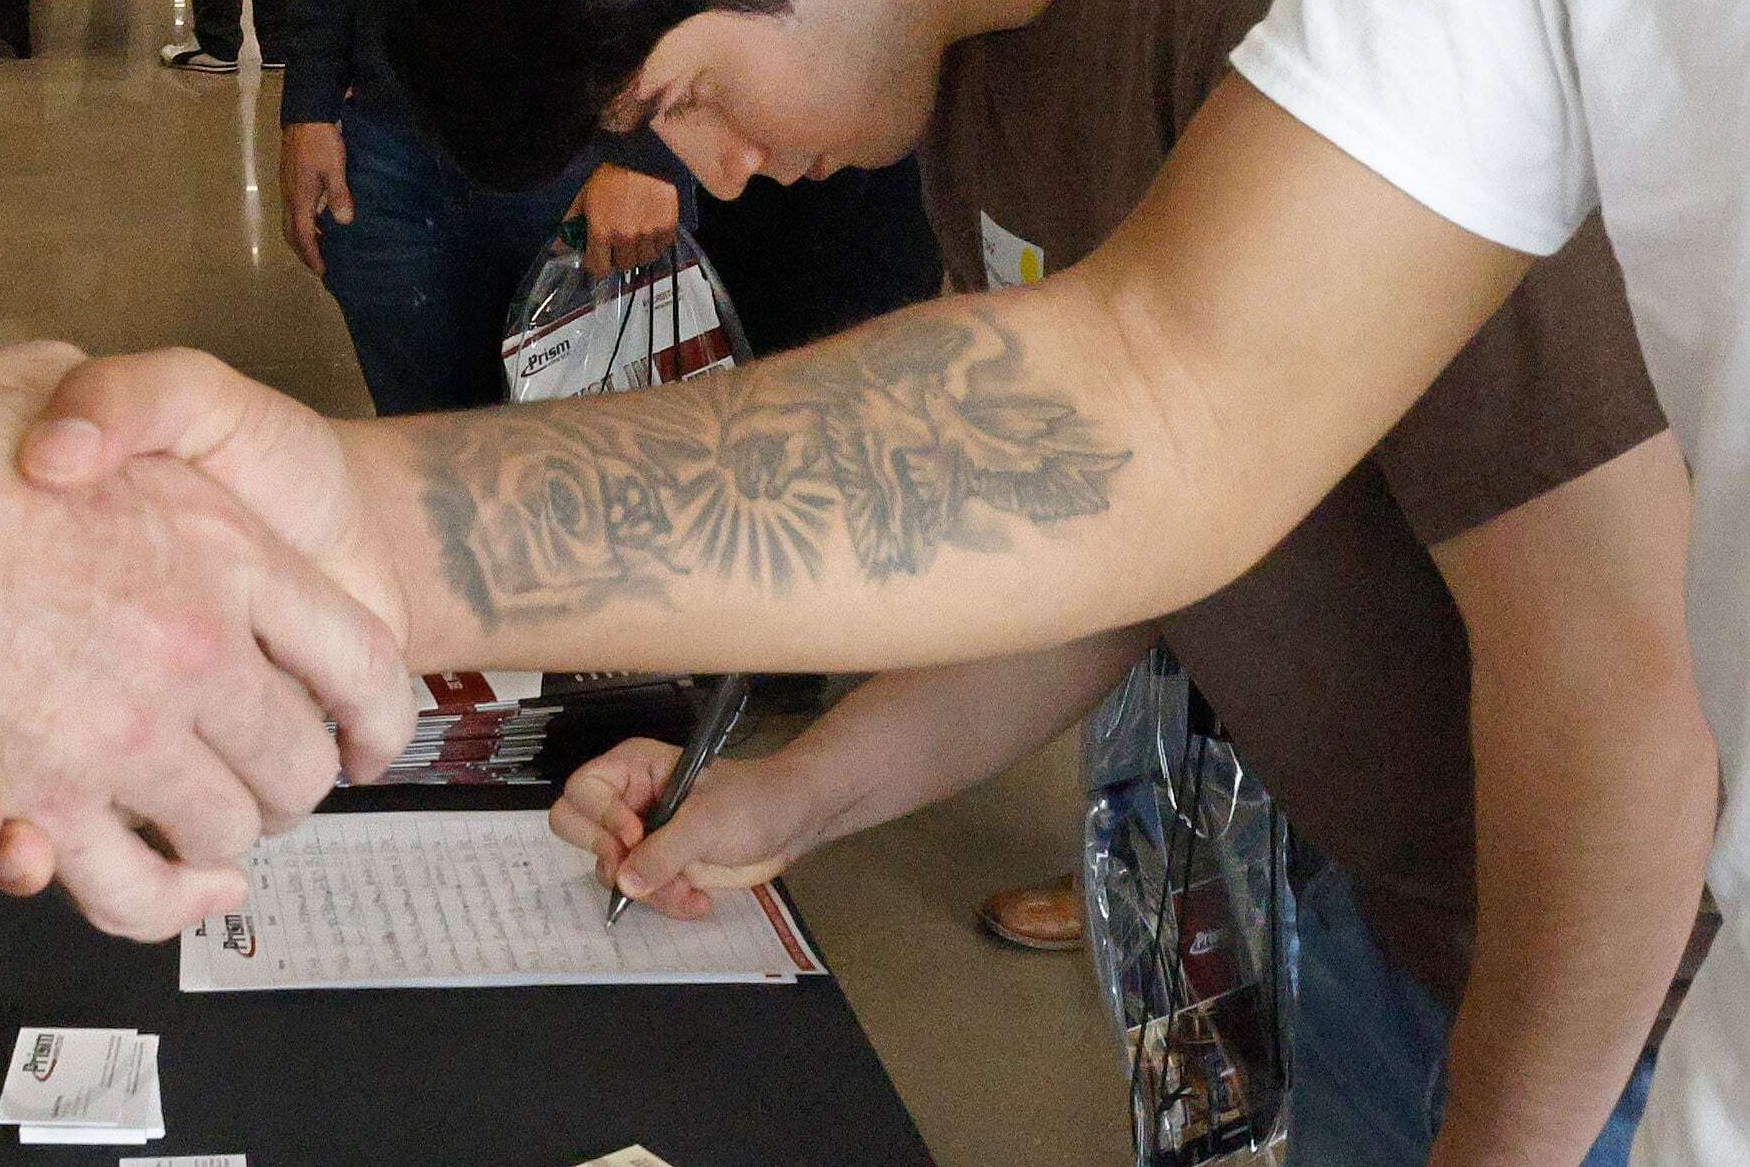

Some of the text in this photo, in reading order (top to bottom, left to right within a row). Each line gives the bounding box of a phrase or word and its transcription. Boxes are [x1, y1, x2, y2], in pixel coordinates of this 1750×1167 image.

[527, 339, 571, 370] Prism
[223, 914, 248, 950] Prism
[22, 1033, 55, 1073] Prism
